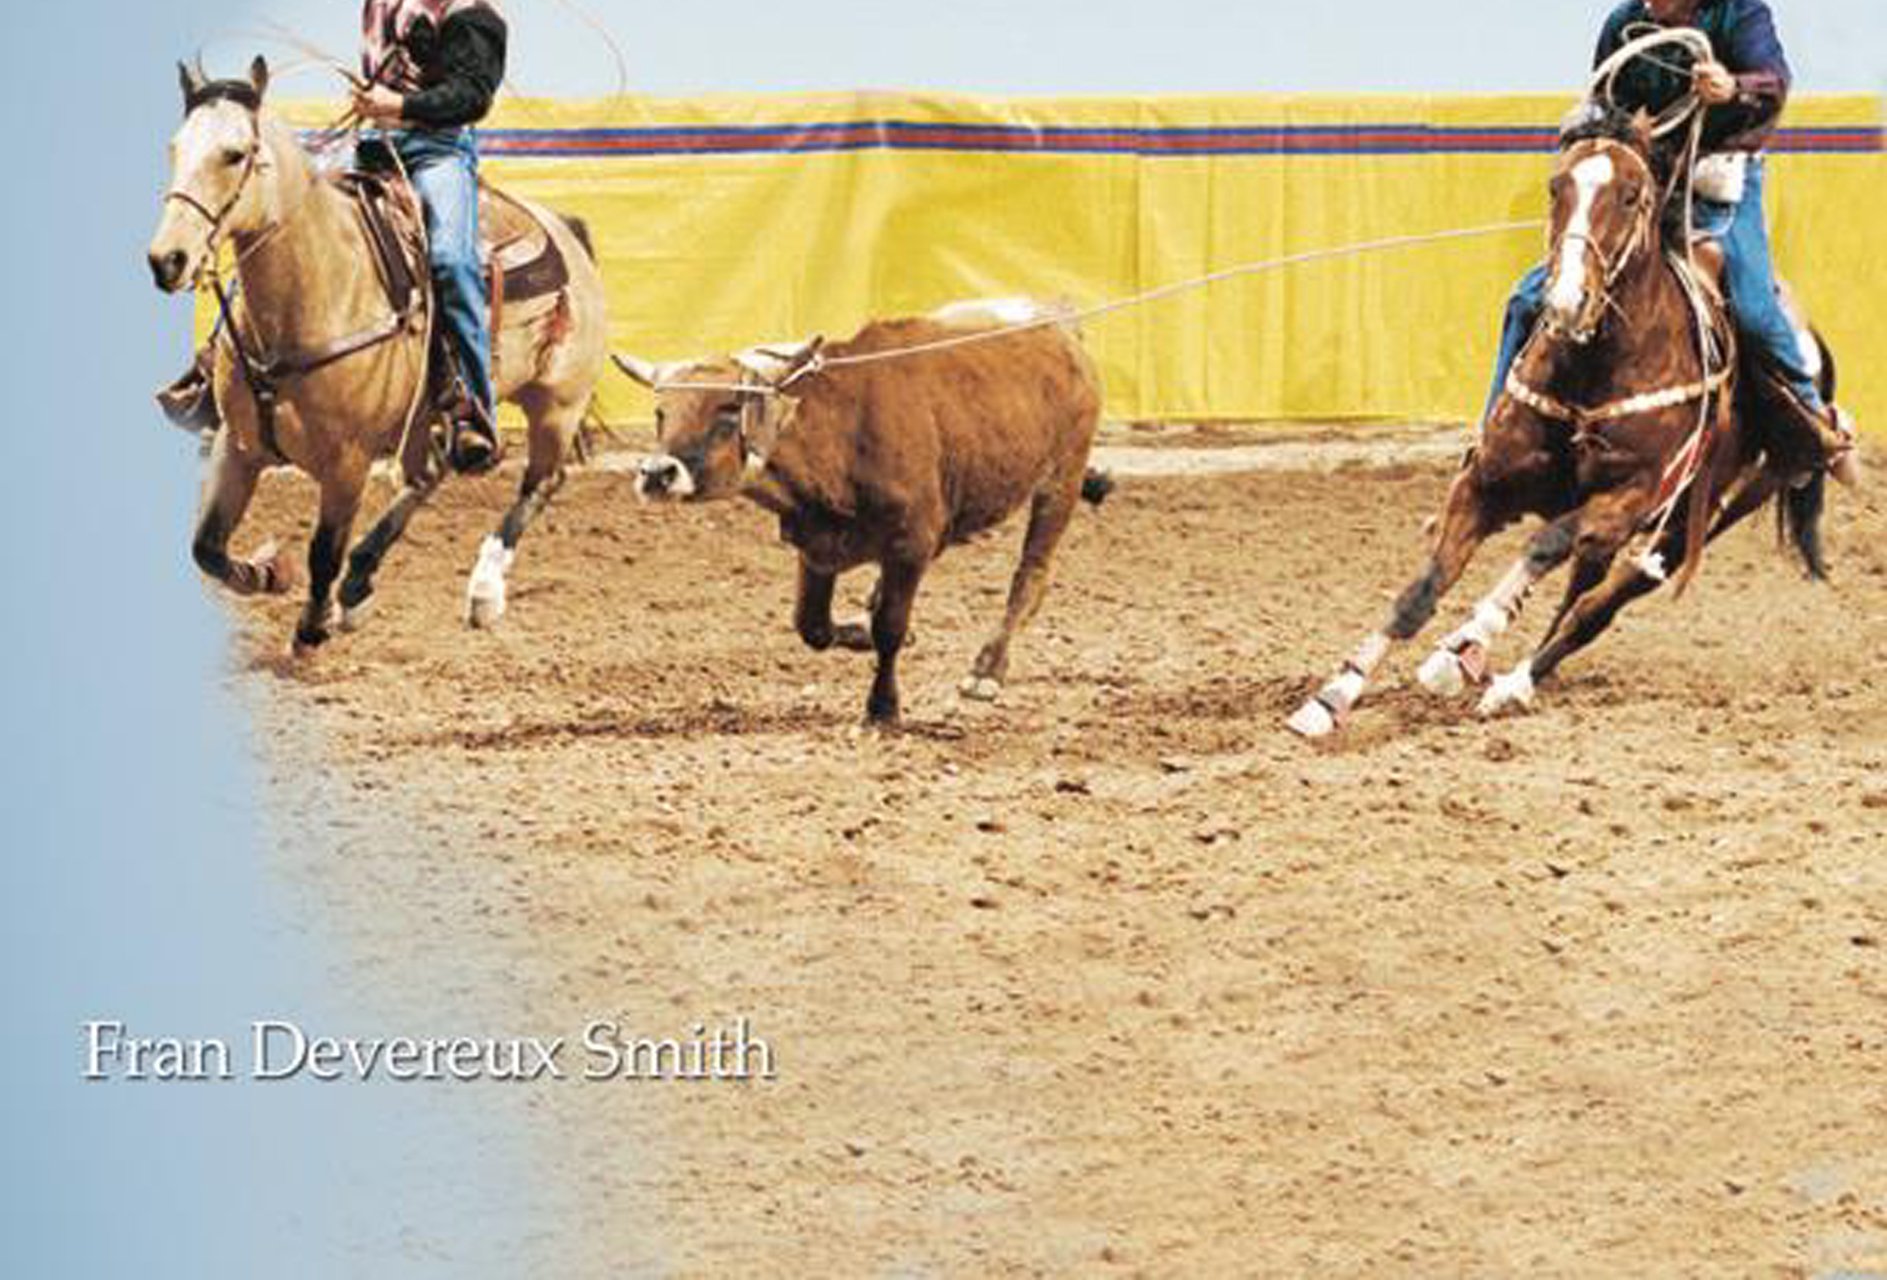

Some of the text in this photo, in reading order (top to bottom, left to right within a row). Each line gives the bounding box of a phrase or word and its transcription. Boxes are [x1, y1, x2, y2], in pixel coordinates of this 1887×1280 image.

[84, 1019, 775, 1081] Fran Devereux Smith
